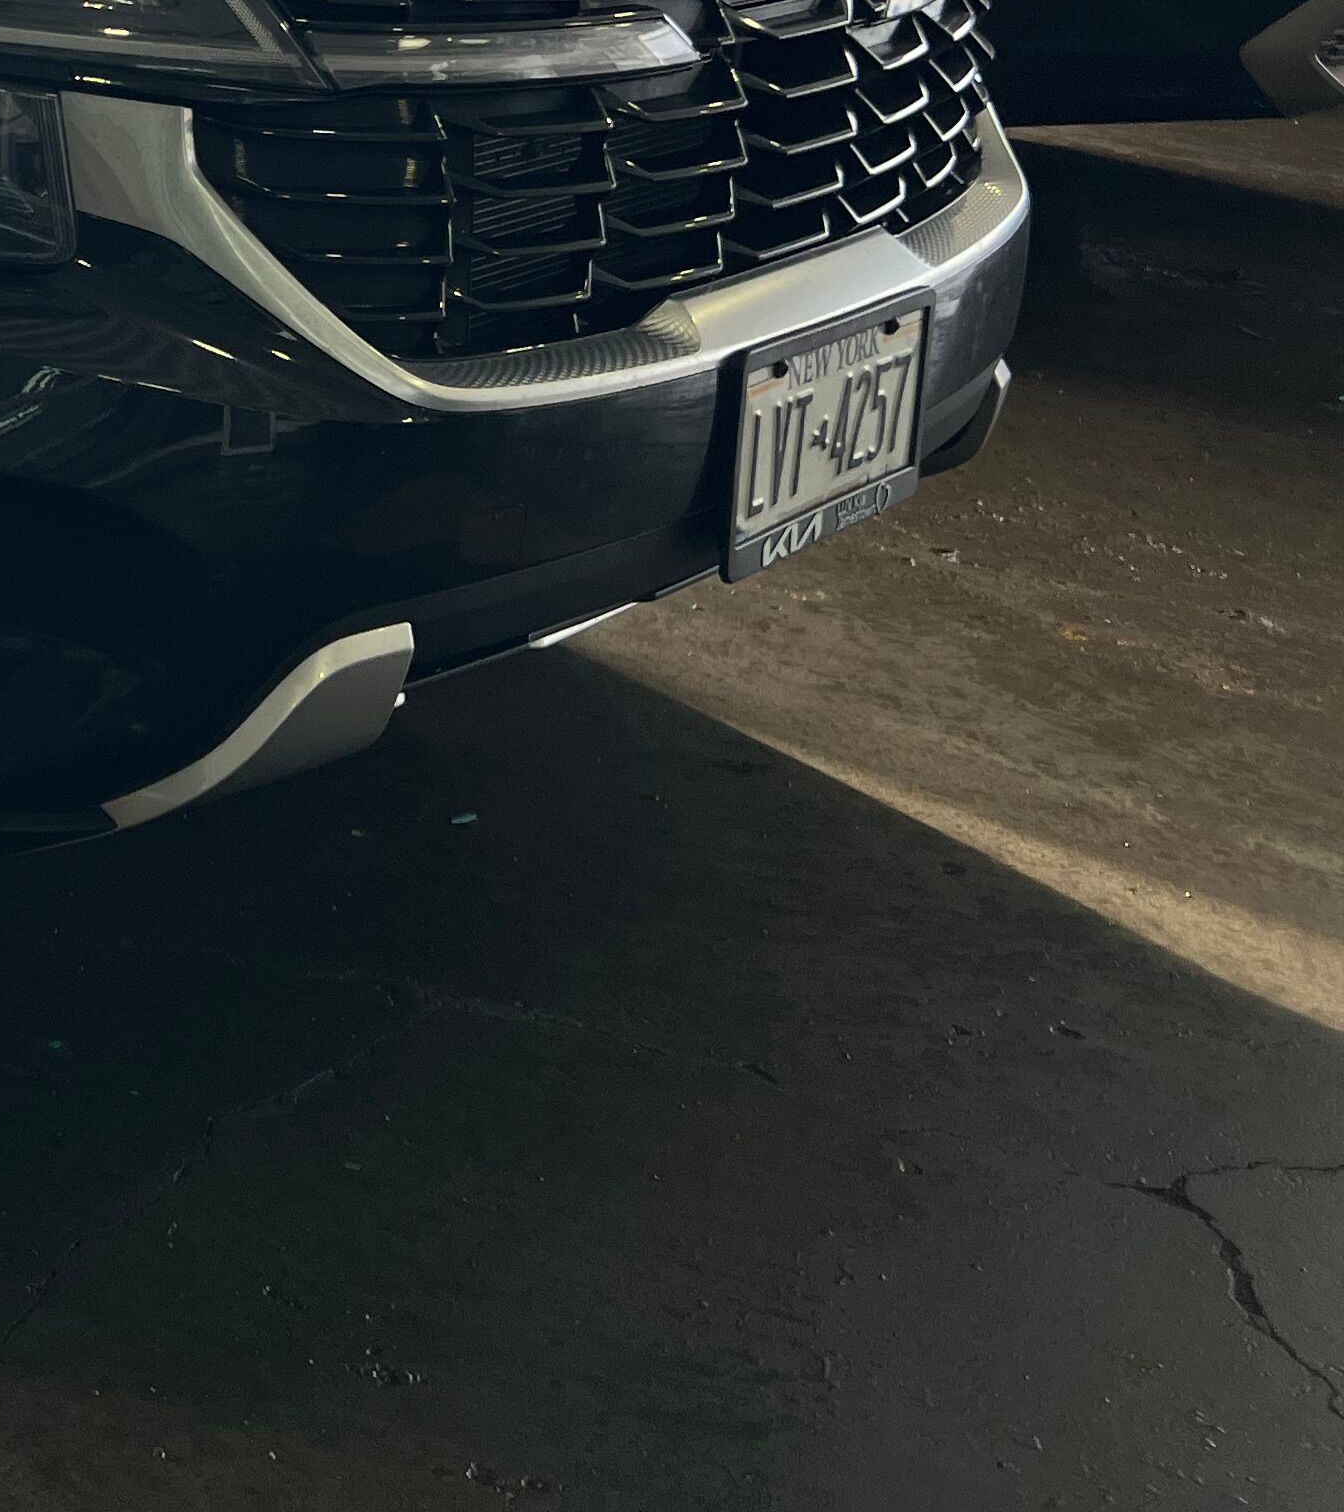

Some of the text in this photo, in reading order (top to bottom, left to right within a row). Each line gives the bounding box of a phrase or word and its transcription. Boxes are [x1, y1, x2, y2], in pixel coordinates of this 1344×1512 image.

[787, 326, 880, 387] NEW YORK
[829, 354, 914, 476] 4257
[762, 510, 823, 568] KIA
